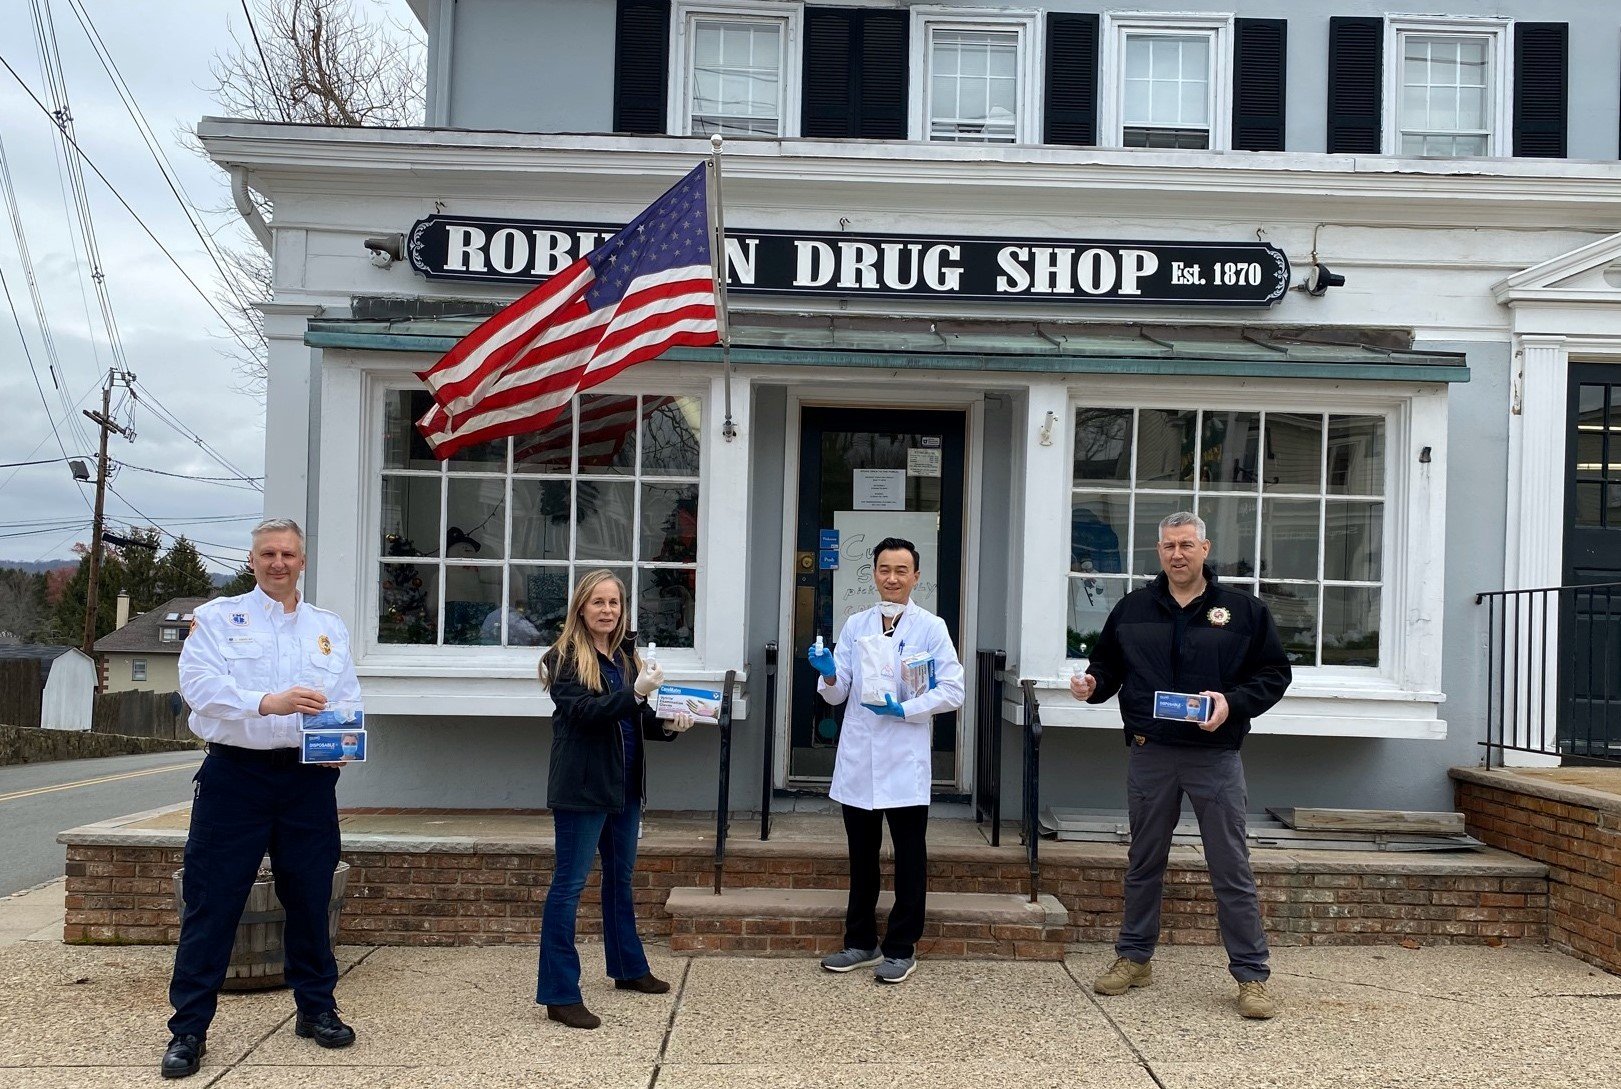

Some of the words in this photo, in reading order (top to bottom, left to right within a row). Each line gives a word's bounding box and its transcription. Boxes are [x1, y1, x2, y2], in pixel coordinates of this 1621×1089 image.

[443, 225, 760, 285] ROBIN
[793, 240, 964, 291] DRUG
[996, 246, 1159, 295] SHOP
[1171, 261, 1206, 285] Est.
[1213, 262, 1262, 286] 1870
